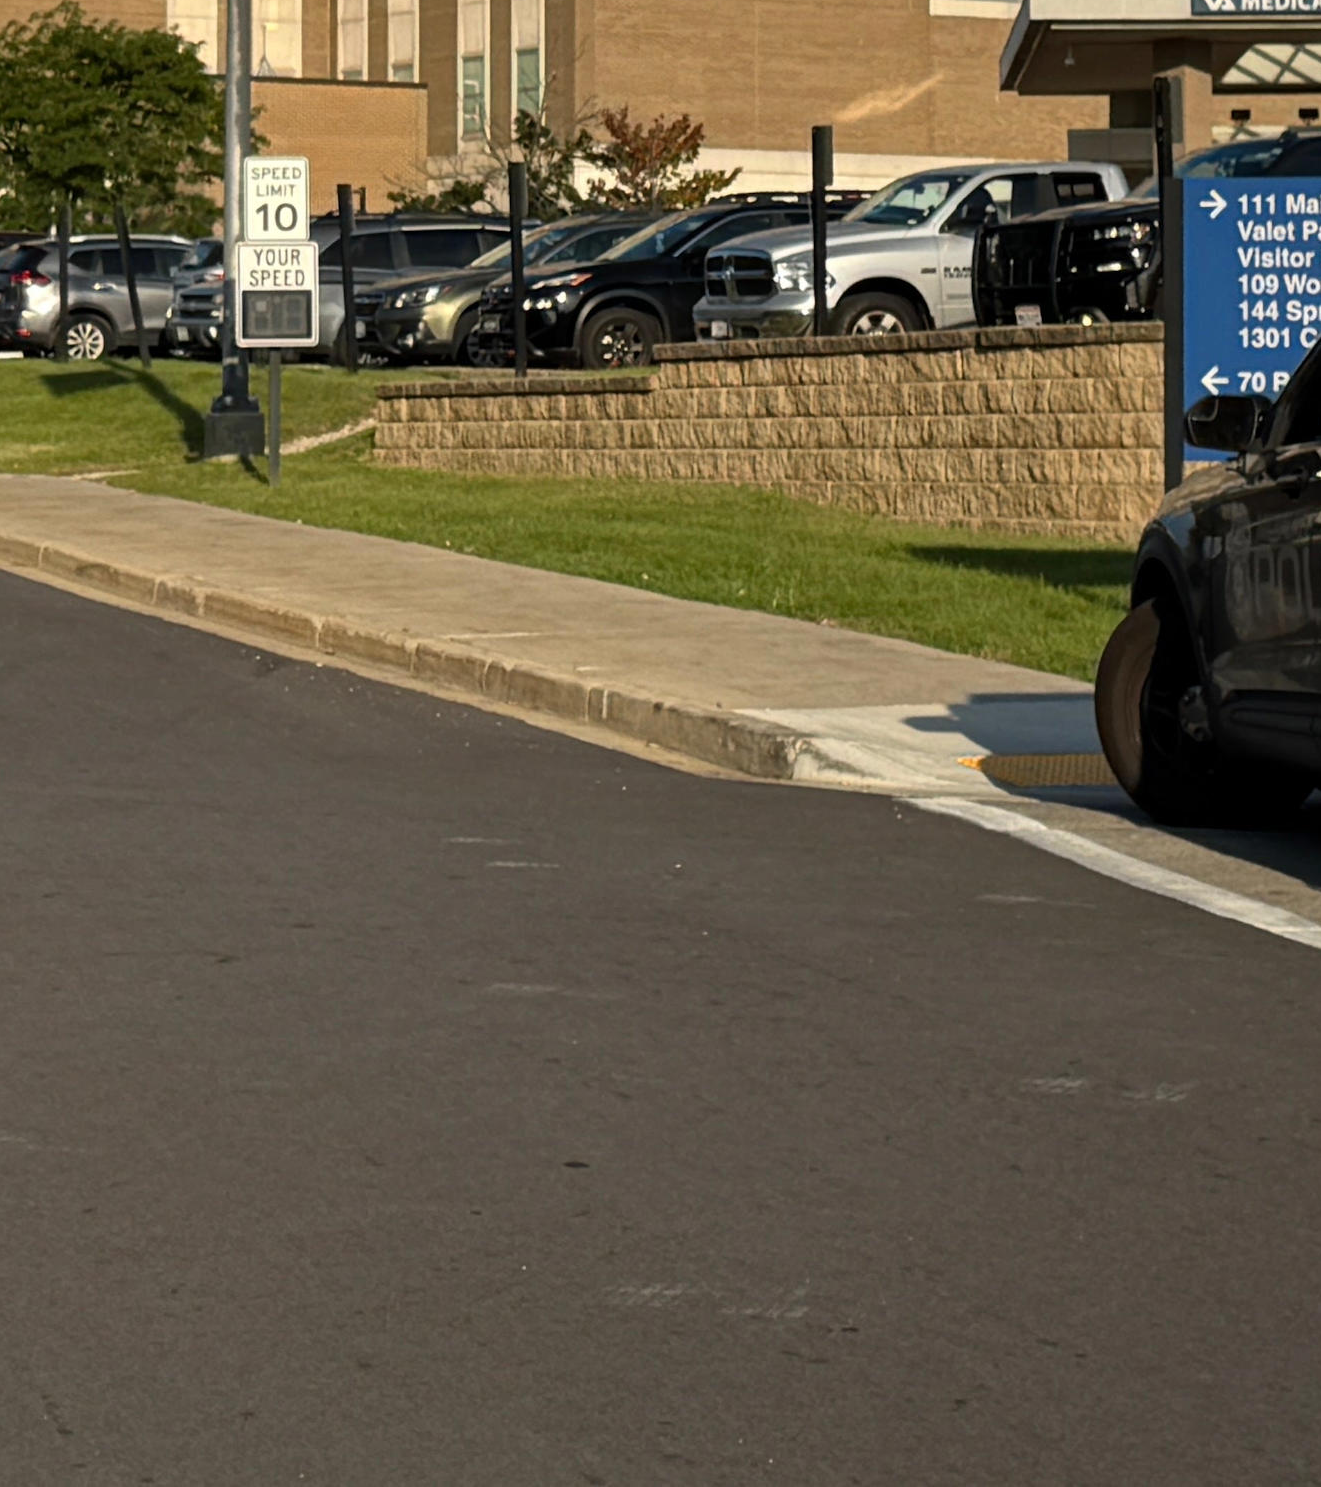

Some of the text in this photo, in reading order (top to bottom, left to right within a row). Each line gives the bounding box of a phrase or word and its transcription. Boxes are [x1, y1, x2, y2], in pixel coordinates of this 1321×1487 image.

[251, 167, 302, 180] SPEED
[256, 184, 296, 197] LIMIT
[1237, 194, 1276, 214] 111
[255, 203, 298, 232] 10
[1237, 220, 1295, 242] Valet
[253, 249, 301, 266] YOUR
[1237, 247, 1315, 268] Visitor
[249, 270, 305, 287] SPEED
[1238, 274, 1278, 295] 109
[1238, 300, 1279, 321] 144
[1238, 327, 1291, 348] 1301
[1237, 371, 1266, 393] 70
